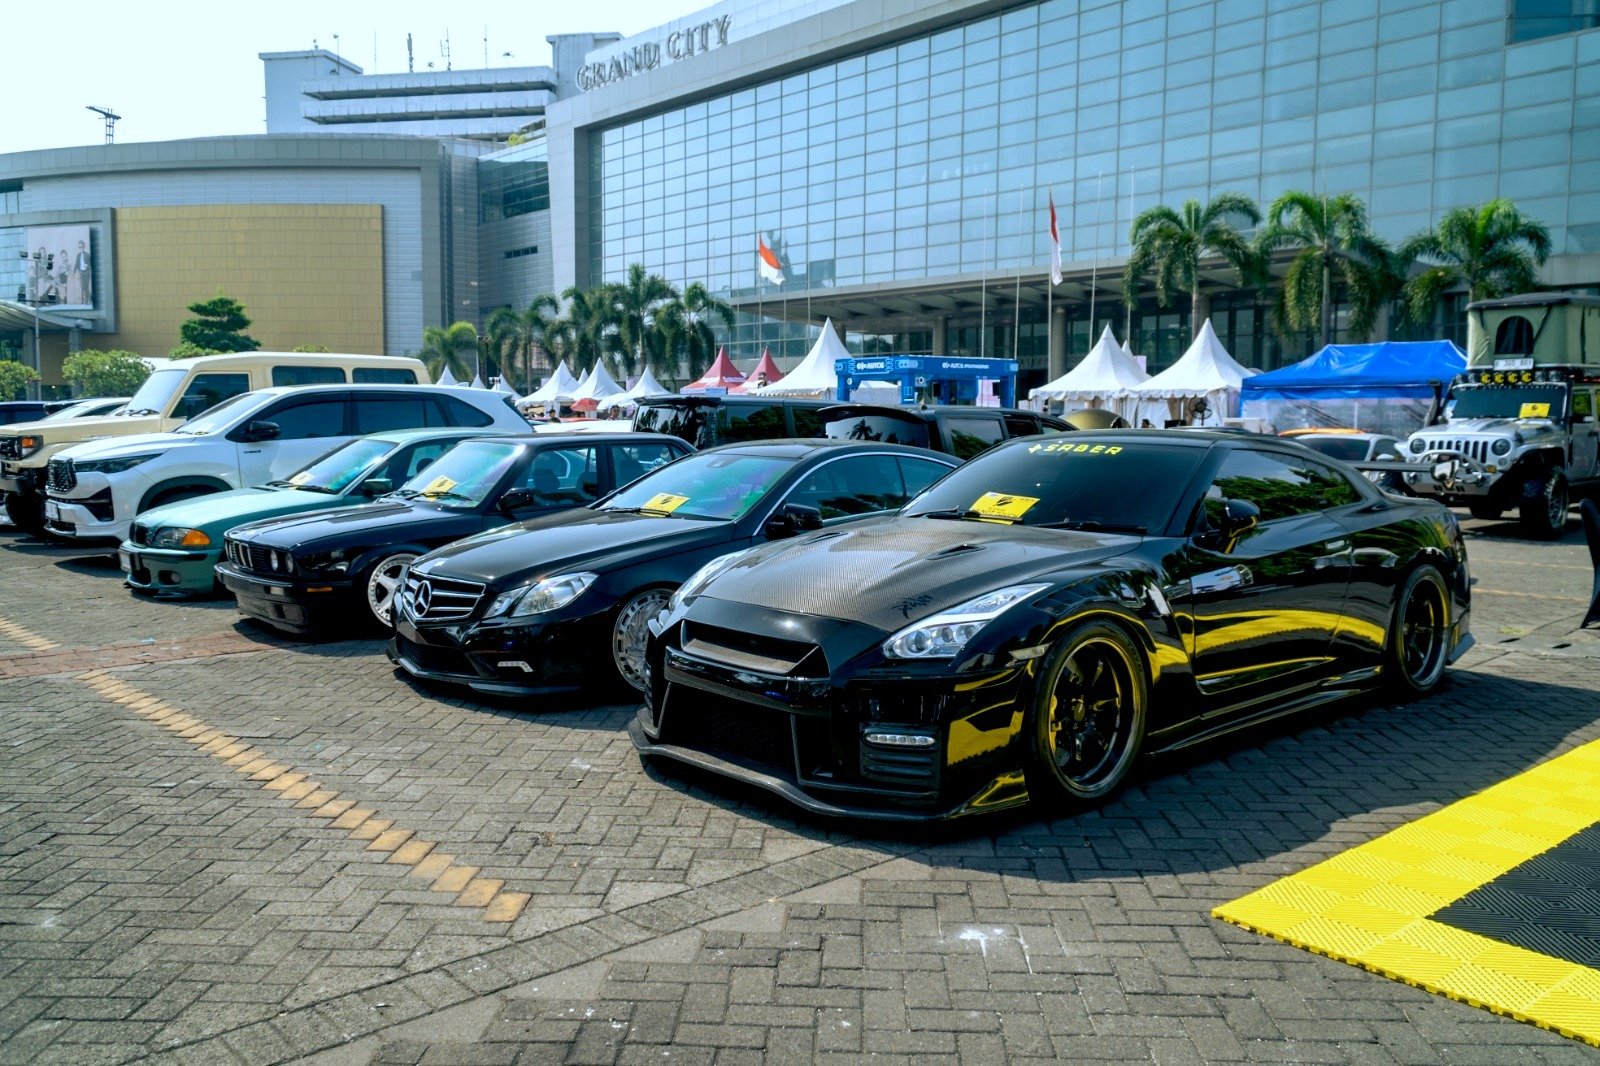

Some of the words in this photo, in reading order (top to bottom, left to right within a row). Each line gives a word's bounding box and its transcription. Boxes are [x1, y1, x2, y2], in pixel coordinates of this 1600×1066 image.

[576, 42, 661, 92] GRAND
[666, 13, 731, 61] CITY
[1043, 443, 1123, 455] SABER
